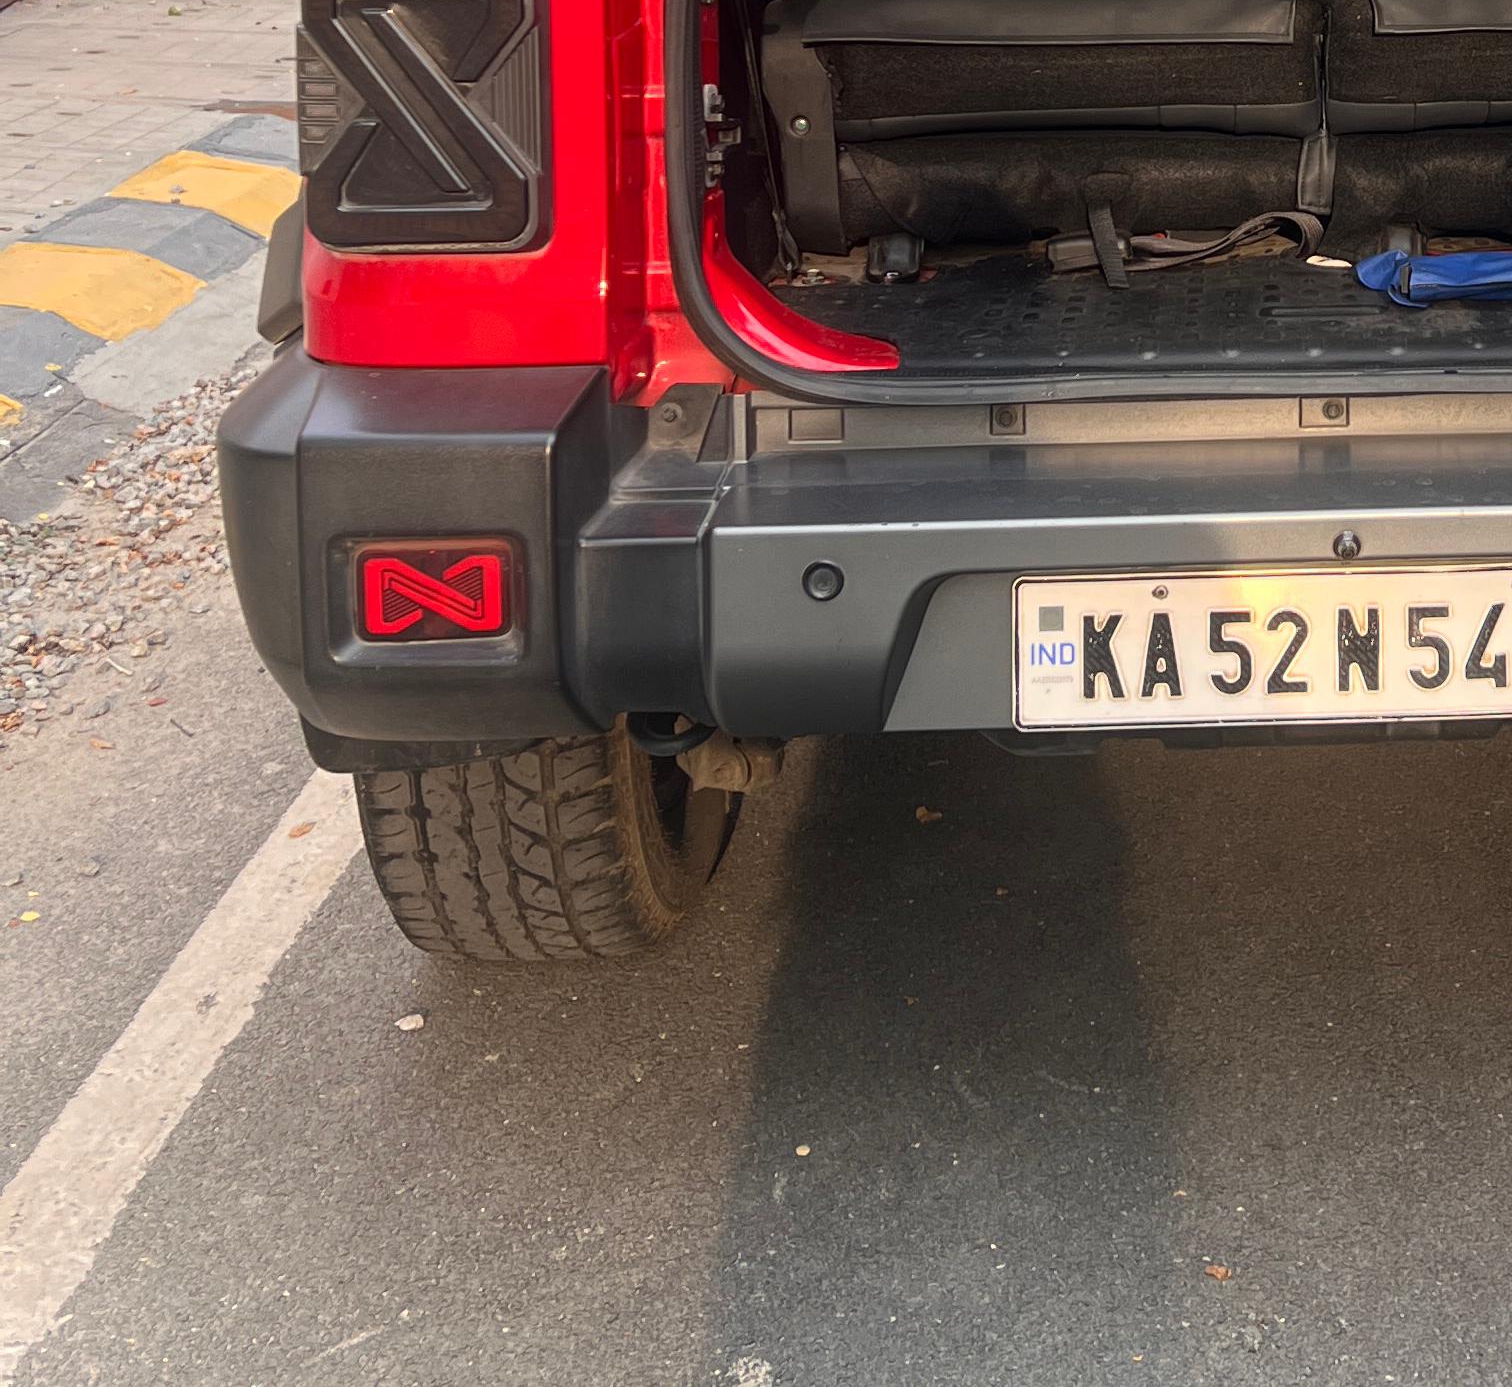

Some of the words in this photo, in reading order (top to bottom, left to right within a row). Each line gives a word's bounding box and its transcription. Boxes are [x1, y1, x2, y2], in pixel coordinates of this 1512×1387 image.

[1030, 642, 1076, 666] IND
[1083, 613, 1183, 699] KA
[1209, 610, 1309, 695] 52
[1337, 608, 1380, 692] N
